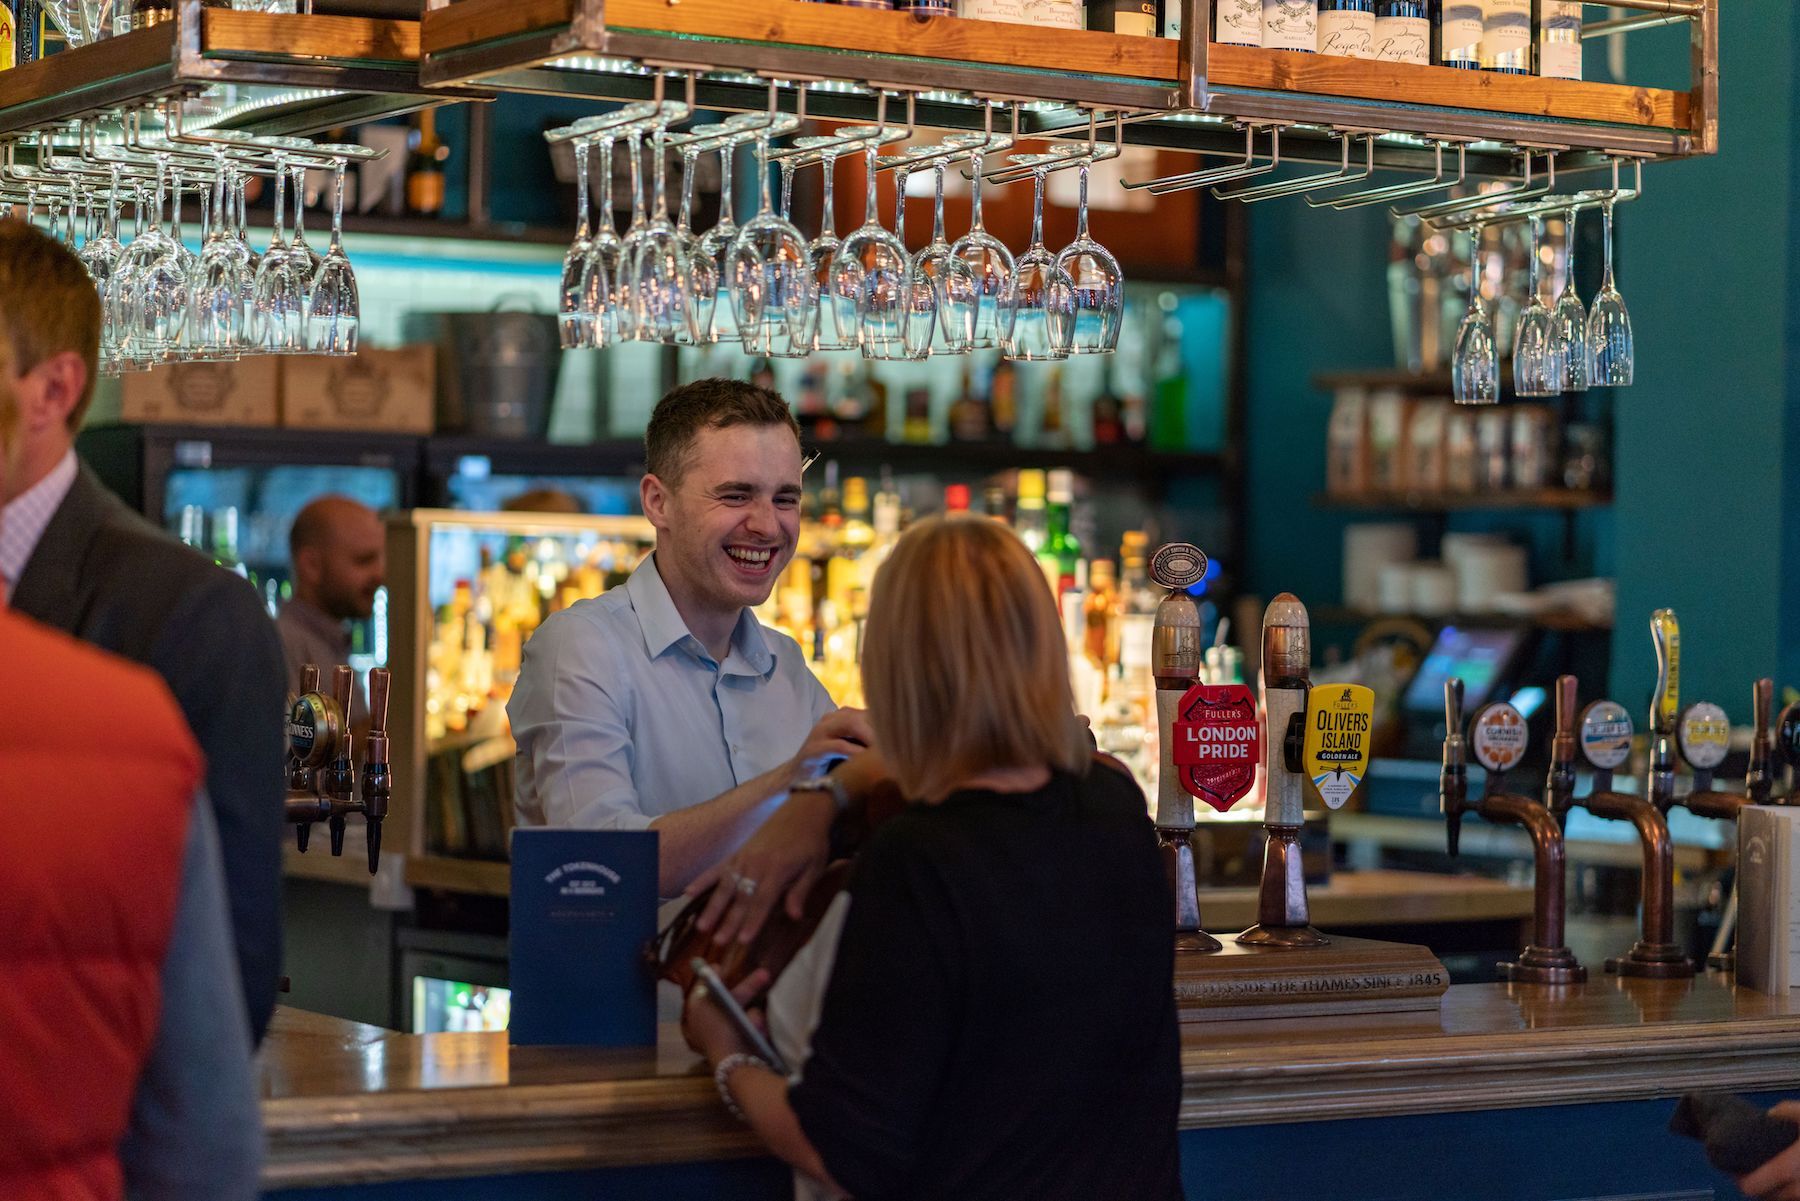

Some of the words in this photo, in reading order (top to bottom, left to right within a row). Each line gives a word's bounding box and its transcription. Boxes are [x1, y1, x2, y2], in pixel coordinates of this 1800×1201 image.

[1320, 32, 1358, 56] Roger
[1376, 38, 1411, 62] Roger
[1205, 709, 1242, 719] FULLER'S
[1317, 709, 1369, 732] OLIVER'S
[1187, 726, 1257, 742] LONDON
[1321, 732, 1361, 749] ISLAND
[1199, 743, 1249, 759] PRIDE
[1321, 752, 1346, 760] GOLDEN
[1347, 752, 1359, 760] ALE
[1272, 981, 1297, 994] THE
[1302, 977, 1360, 992] THAMES
[1362, 975, 1404, 990] SINCE
[1409, 973, 1441, 987] 1845
